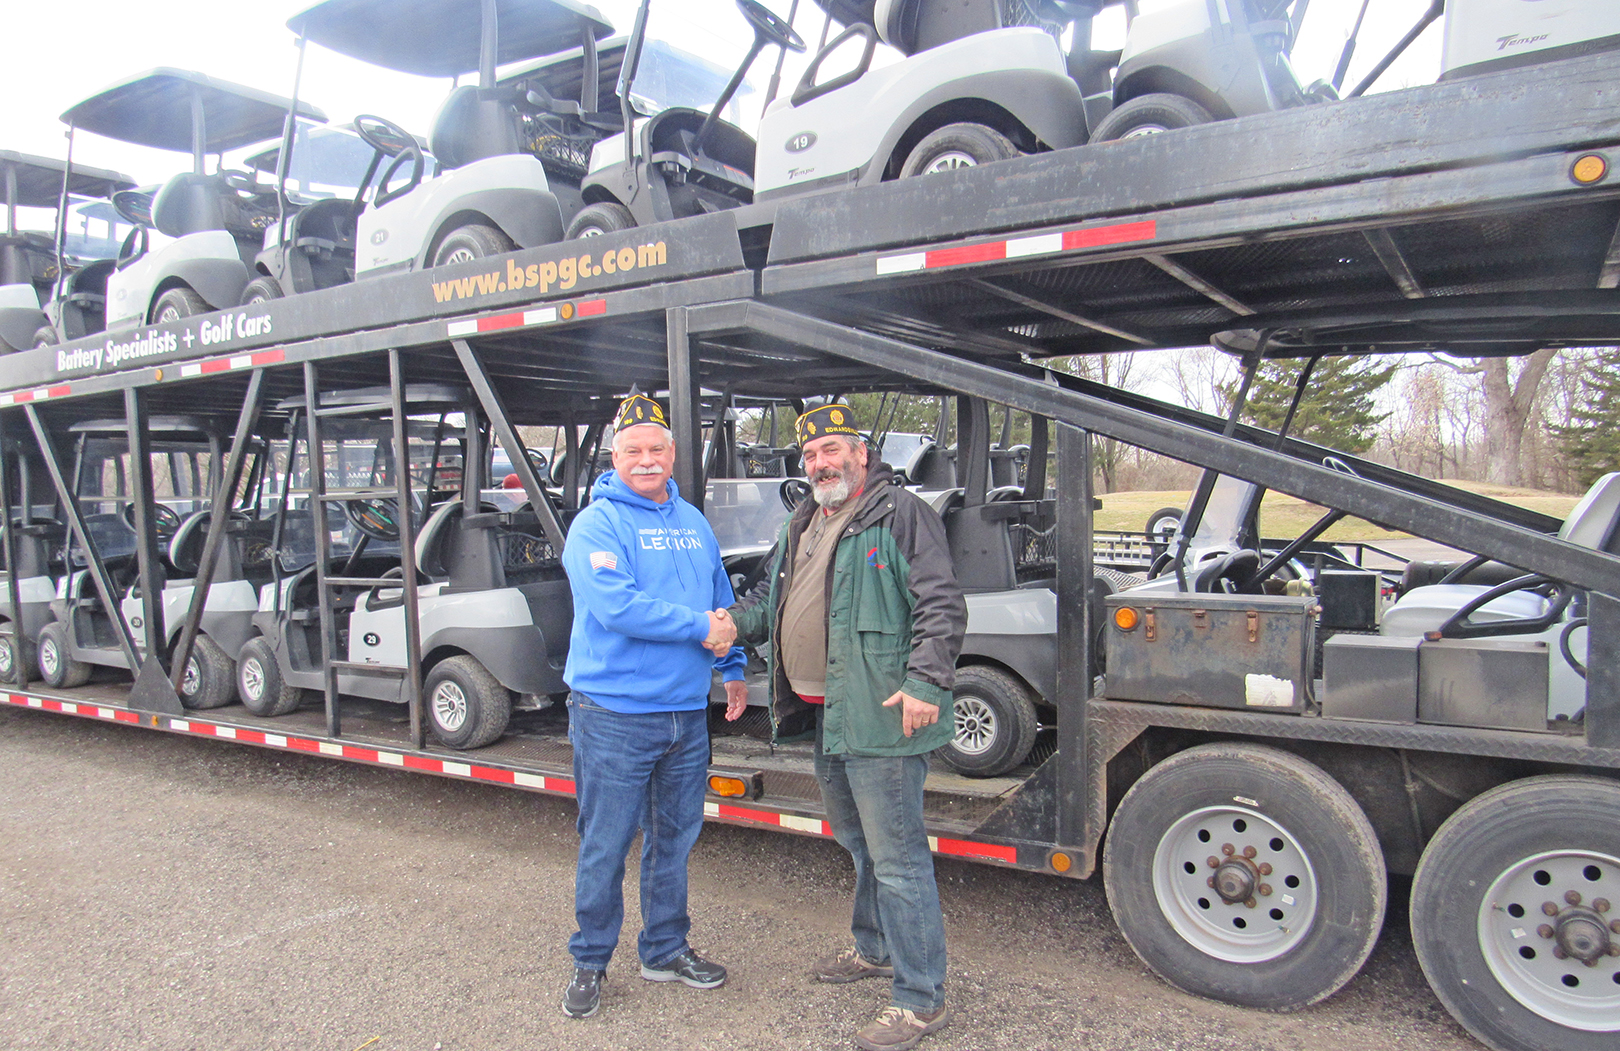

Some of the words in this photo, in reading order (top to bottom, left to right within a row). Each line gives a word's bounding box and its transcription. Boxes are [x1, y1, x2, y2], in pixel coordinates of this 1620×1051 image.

[1495, 32, 1549, 51] Tempo
[793, 136, 809, 150] 19
[432, 241, 667, 303] www.bspgc.com
[57, 348, 104, 372] Battery
[105, 329, 177, 366] Specialists
[200, 313, 234, 346] Golf
[236, 312, 272, 339] Cars
[640, 536, 703, 551] LEGION
